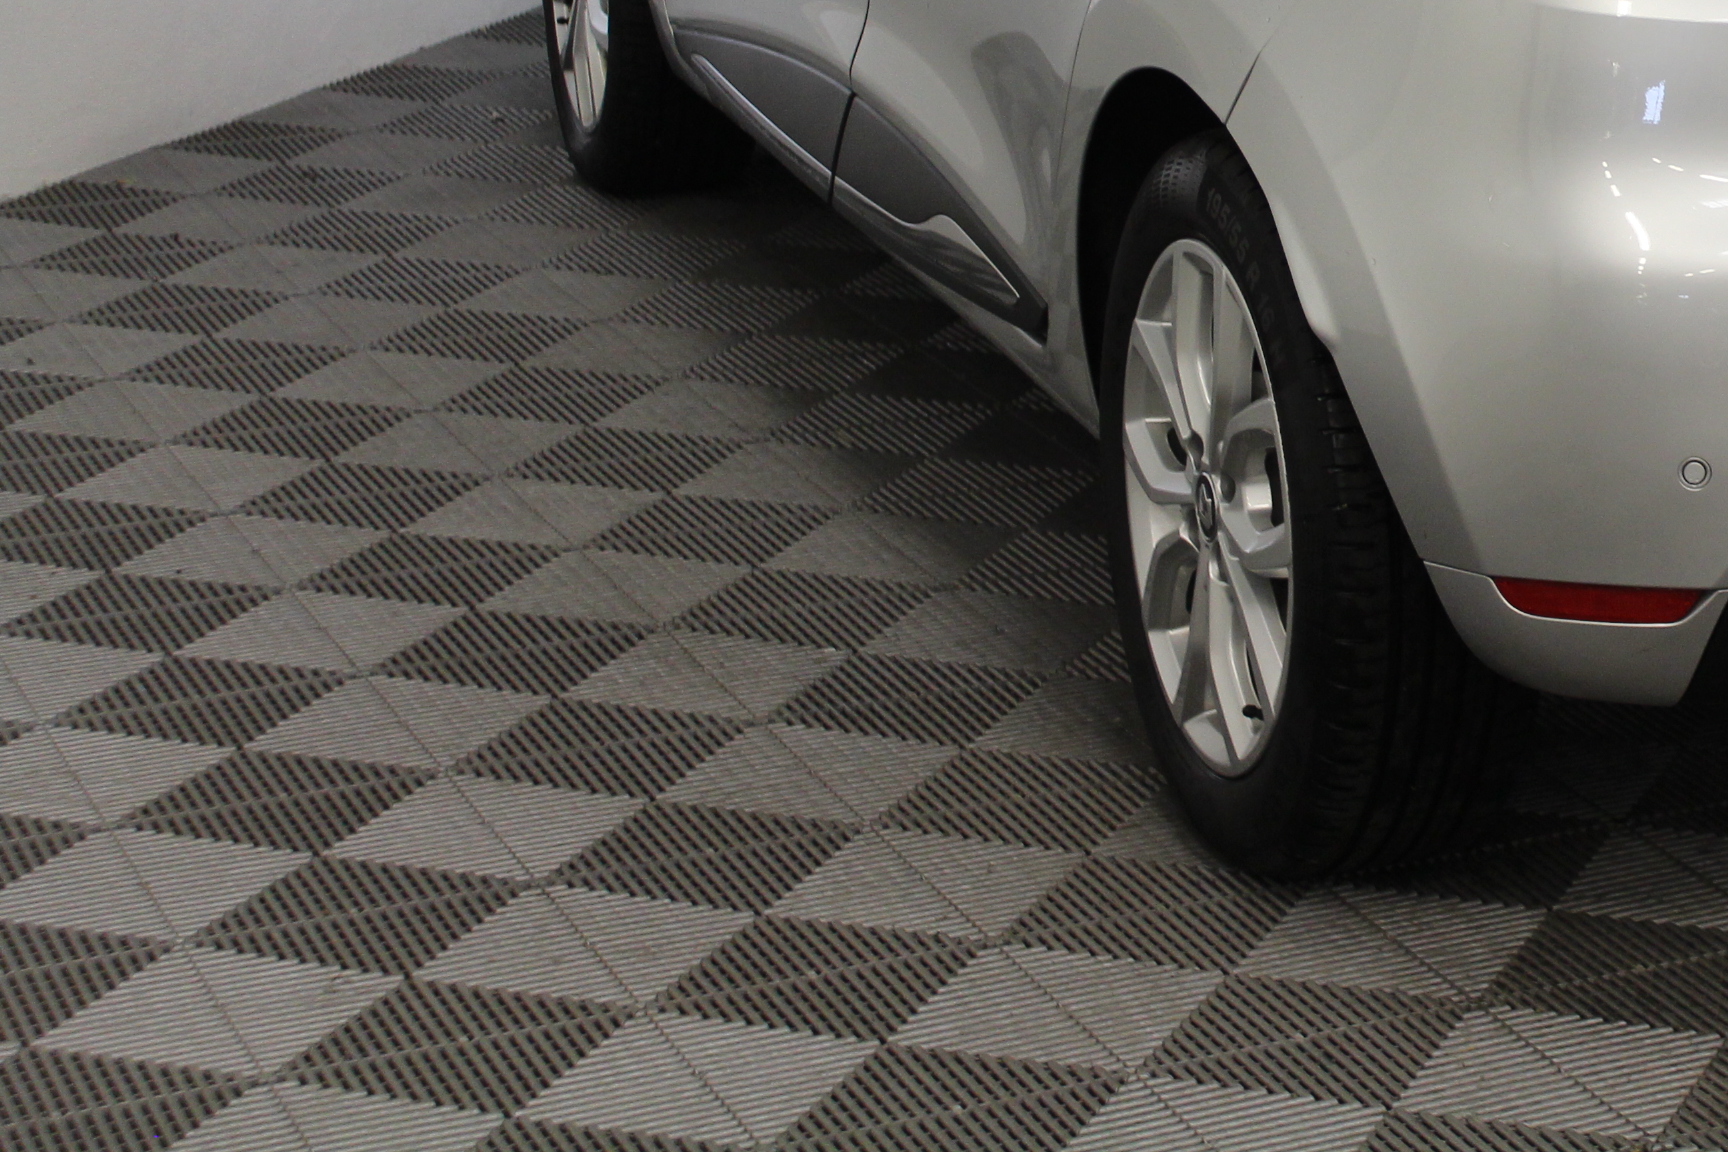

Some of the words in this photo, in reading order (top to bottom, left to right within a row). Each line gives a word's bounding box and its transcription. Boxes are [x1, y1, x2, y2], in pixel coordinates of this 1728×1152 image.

[1205, 187, 1249, 266] 195/55
[1245, 259, 1261, 294] R
[1256, 290, 1275, 333] 16
